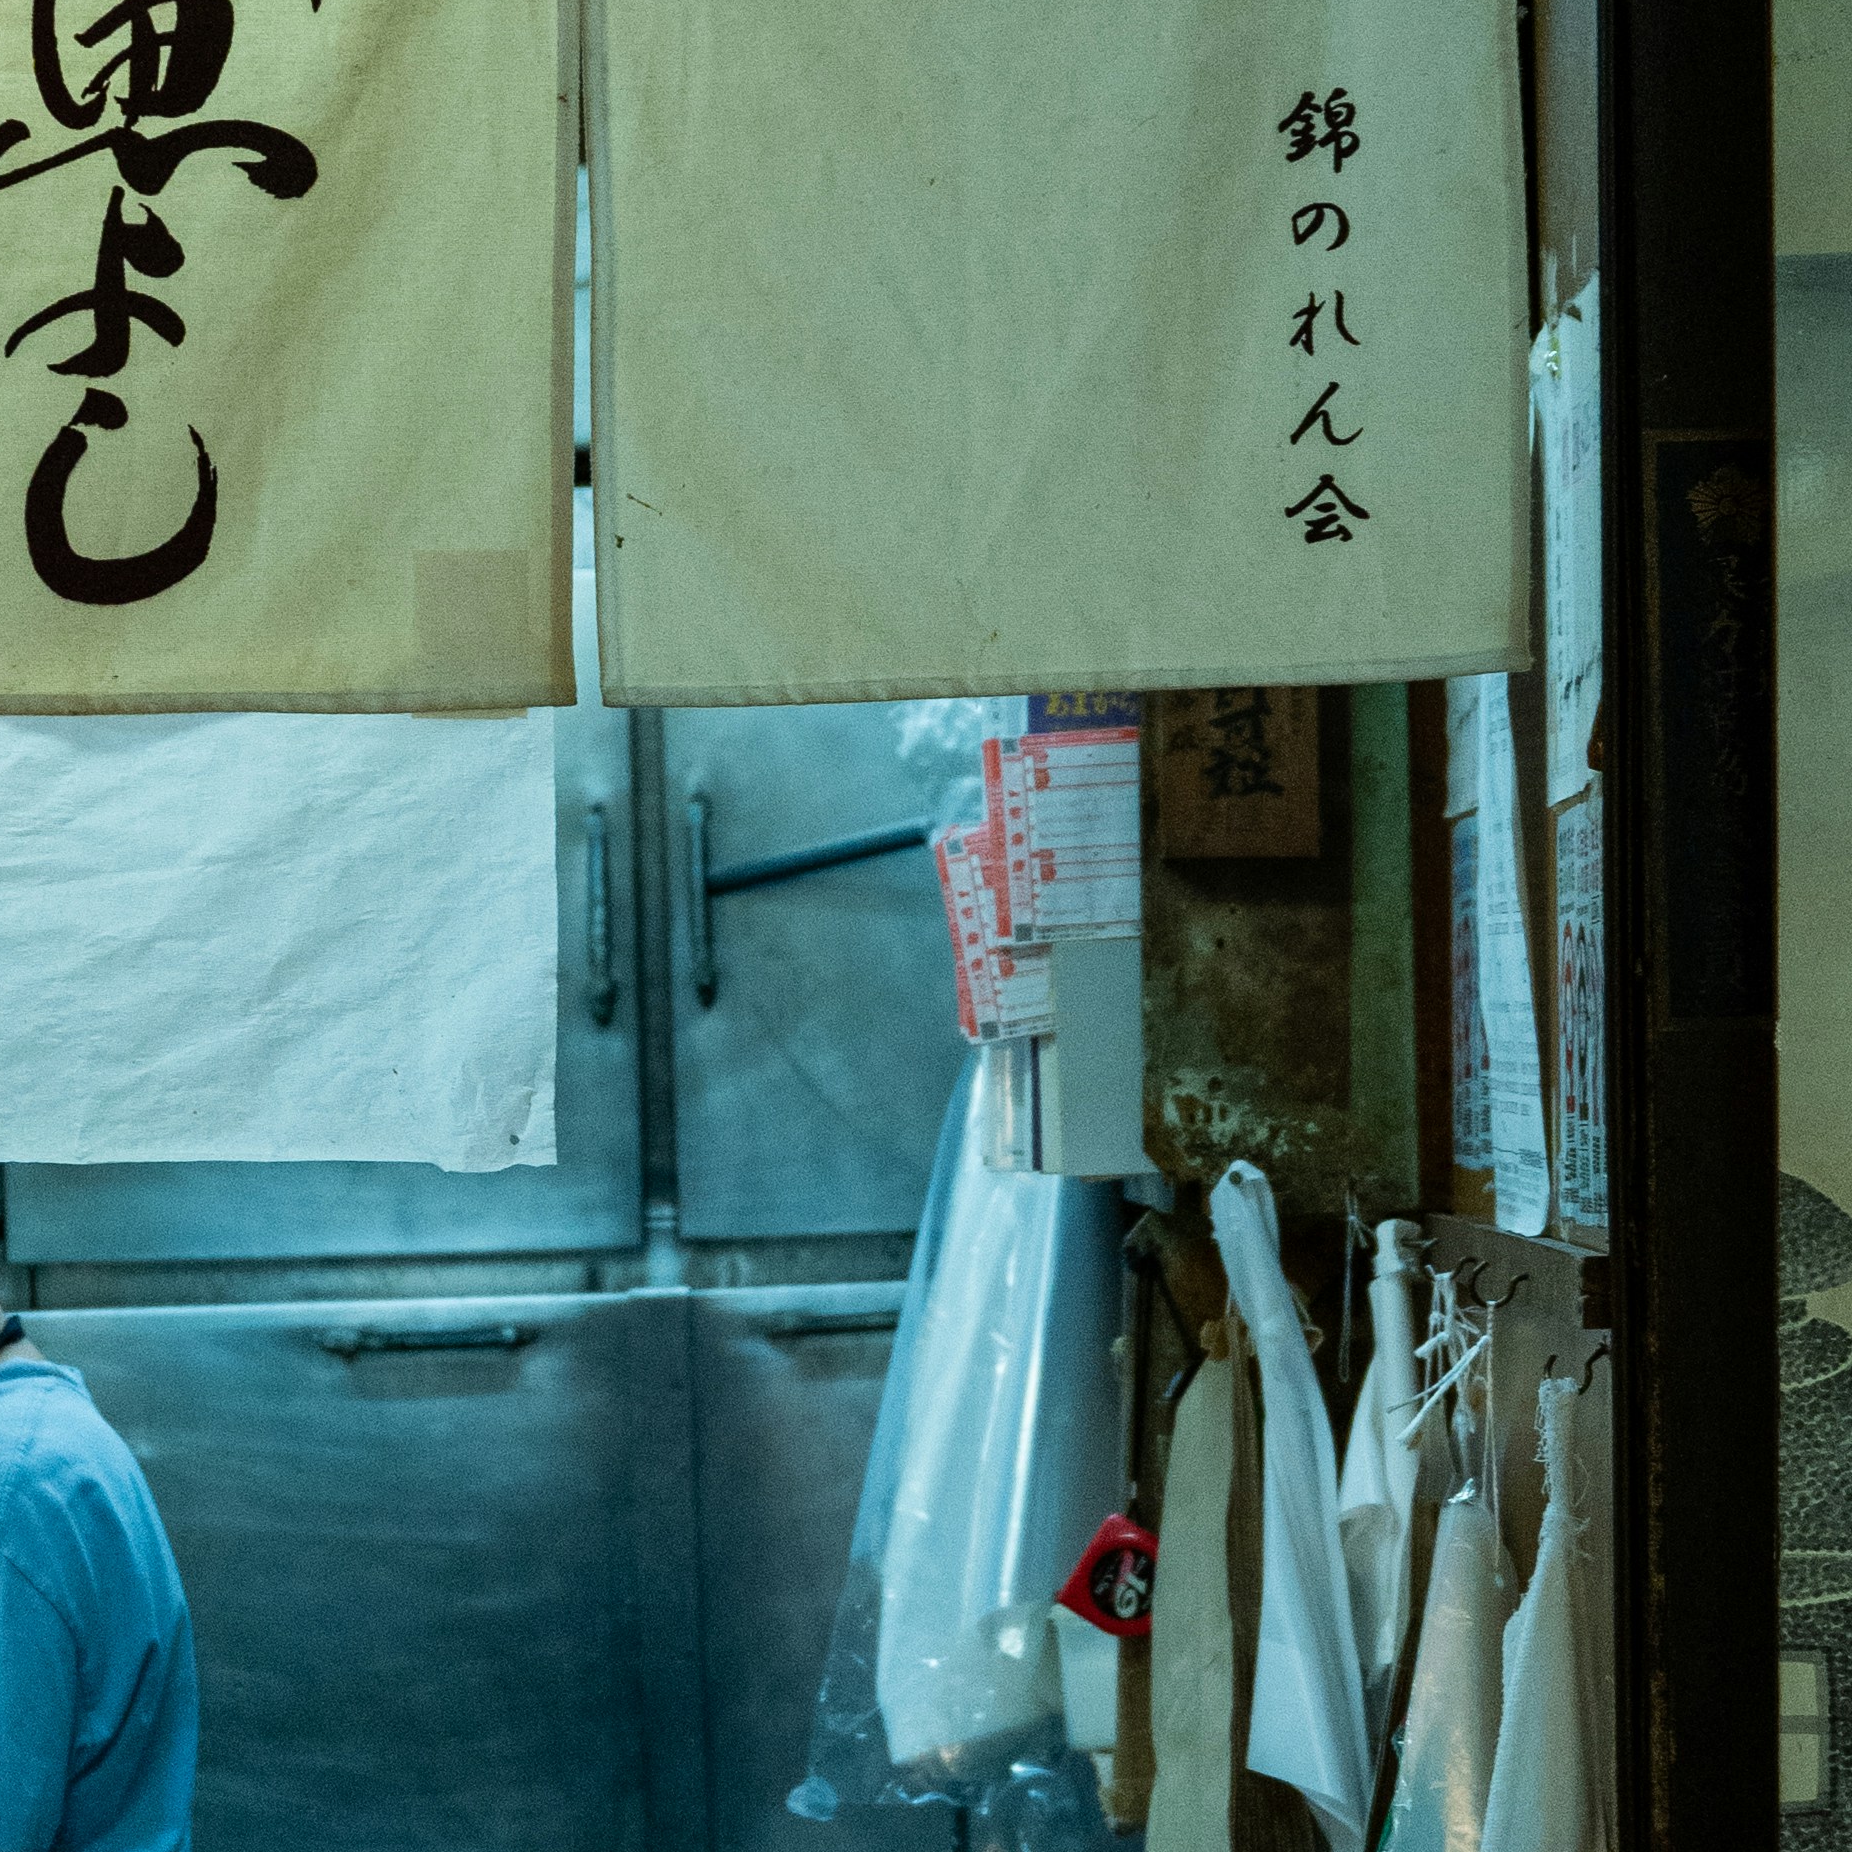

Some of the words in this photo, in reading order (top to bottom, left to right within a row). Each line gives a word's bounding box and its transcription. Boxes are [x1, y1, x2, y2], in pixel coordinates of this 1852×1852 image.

[1277, 86, 1371, 545] 錦のれん会
